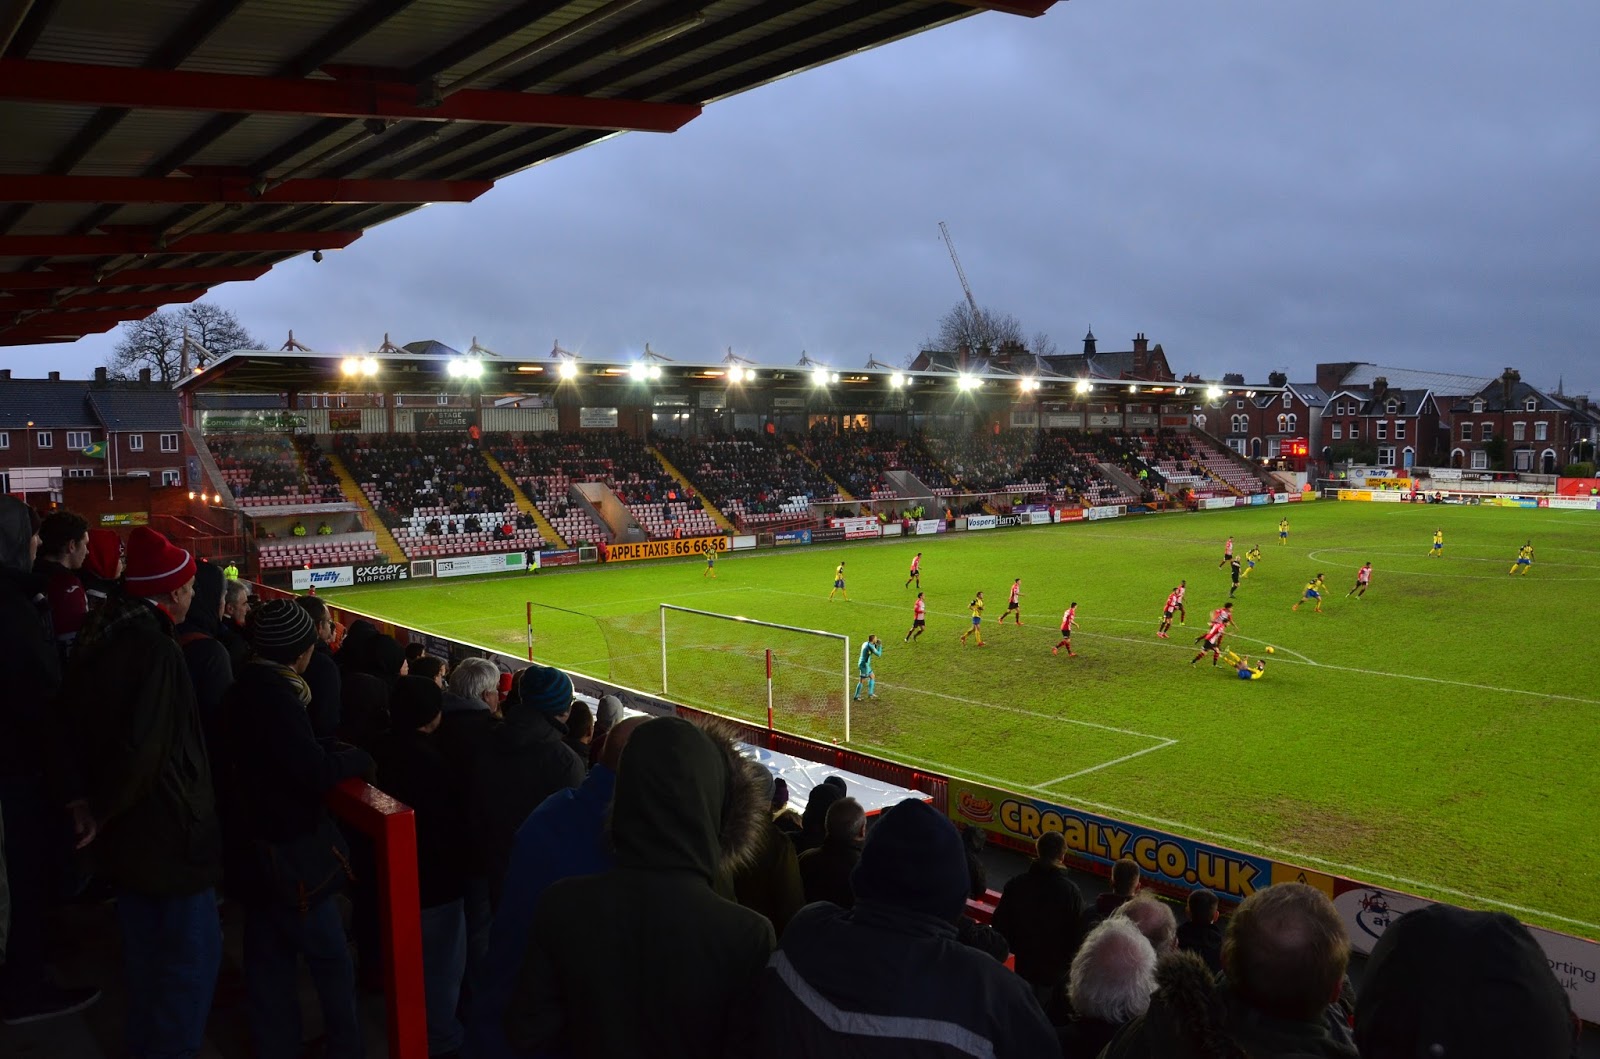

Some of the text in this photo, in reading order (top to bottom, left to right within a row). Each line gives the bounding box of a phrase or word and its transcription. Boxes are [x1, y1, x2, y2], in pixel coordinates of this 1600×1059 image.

[205, 419, 248, 428] Community
[969, 518, 995, 527] Vospers
[995, 515, 1021, 526] Harry's
[611, 545, 640, 560] APPLE
[642, 543, 669, 558] TAXIS
[356, 564, 401, 576] exeter
[357, 573, 397, 583] AIRPORT
